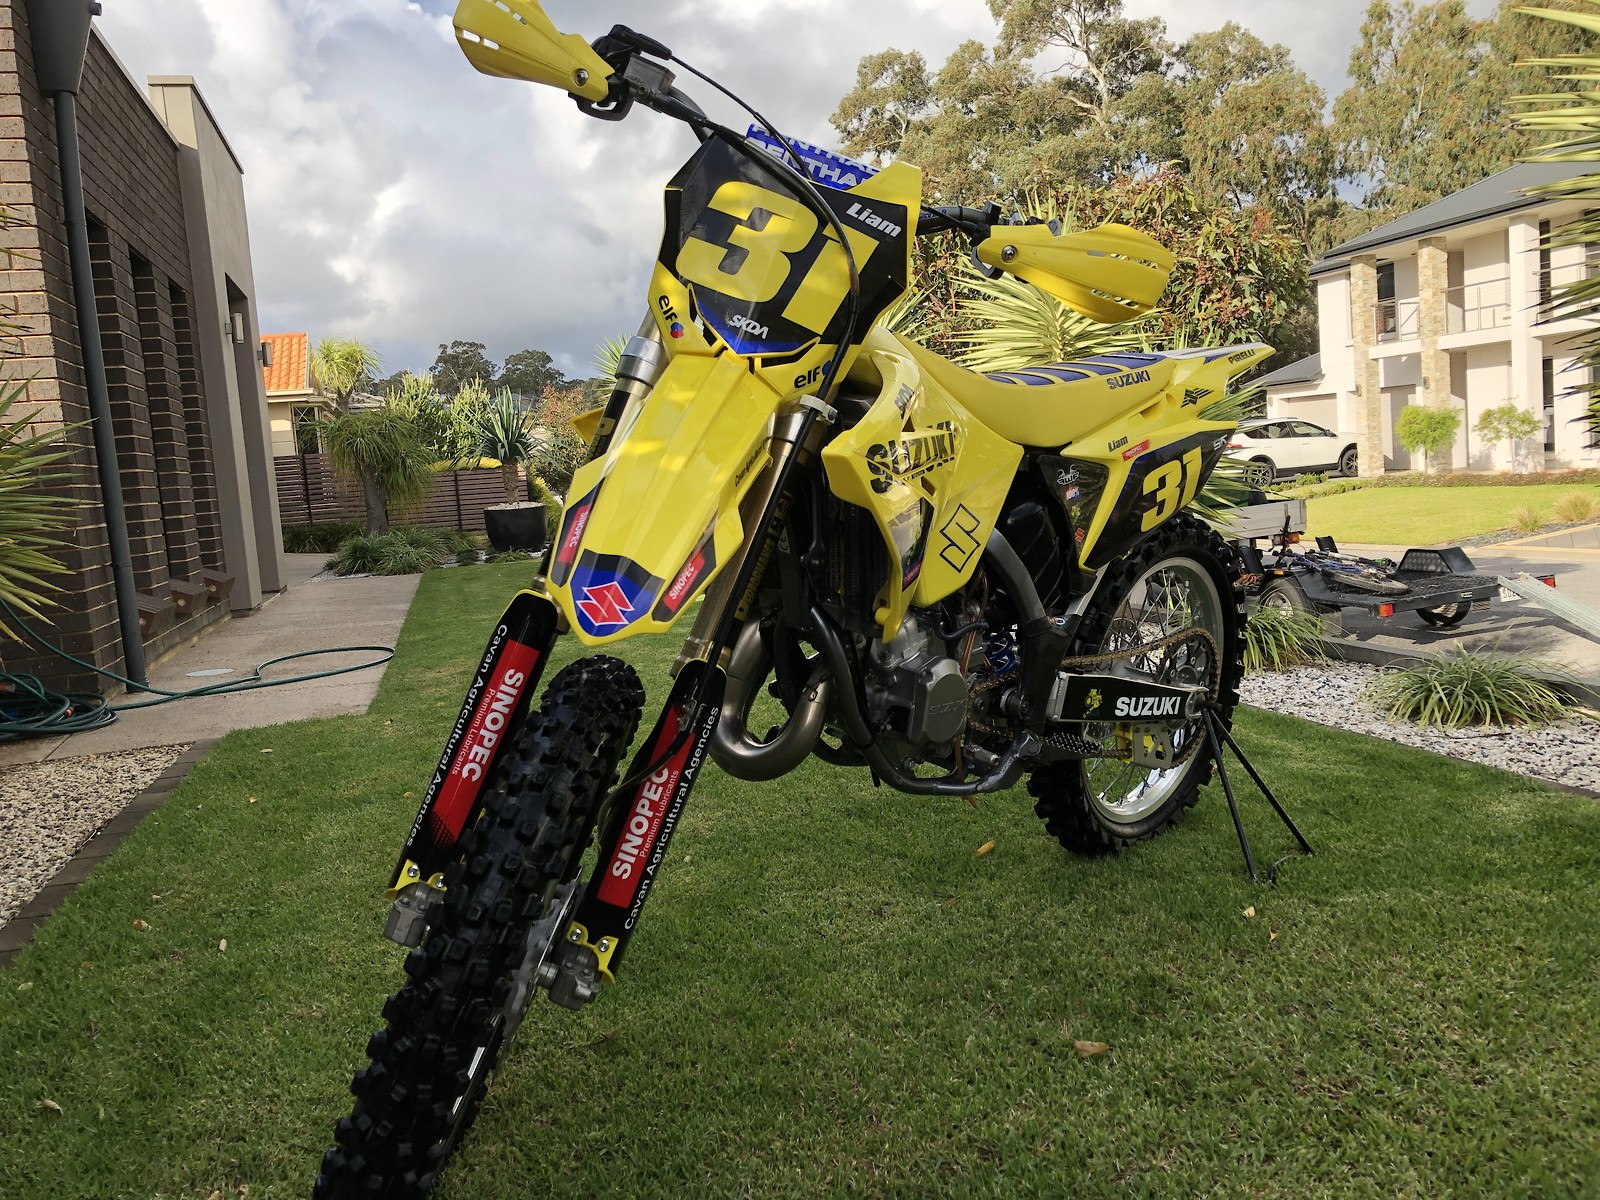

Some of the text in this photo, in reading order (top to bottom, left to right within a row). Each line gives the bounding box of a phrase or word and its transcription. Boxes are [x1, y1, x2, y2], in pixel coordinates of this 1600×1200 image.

[846, 202, 903, 238] Liam
[675, 181, 880, 336] 31
[658, 294, 678, 322] elf
[729, 314, 769, 340] SKDA
[1228, 349, 1256, 365] PIRELLI
[794, 365, 820, 389] elf
[1106, 370, 1151, 390] SUZUKI
[1108, 436, 1129, 453] Liam
[1141, 446, 1203, 532] 31
[669, 563, 695, 600] SINOPEC
[462, 668, 524, 782] SINOPEC
[1114, 696, 1181, 717] SUZUKI
[406, 624, 508, 847] Cavan Agricultural Agencies
[452, 688, 496, 775] Premium Lubricants
[612, 767, 669, 880] SINOPEC
[624, 707, 719, 930] Cavan Agricultural Agencies
[639, 770, 679, 858] Premium Lubricants
